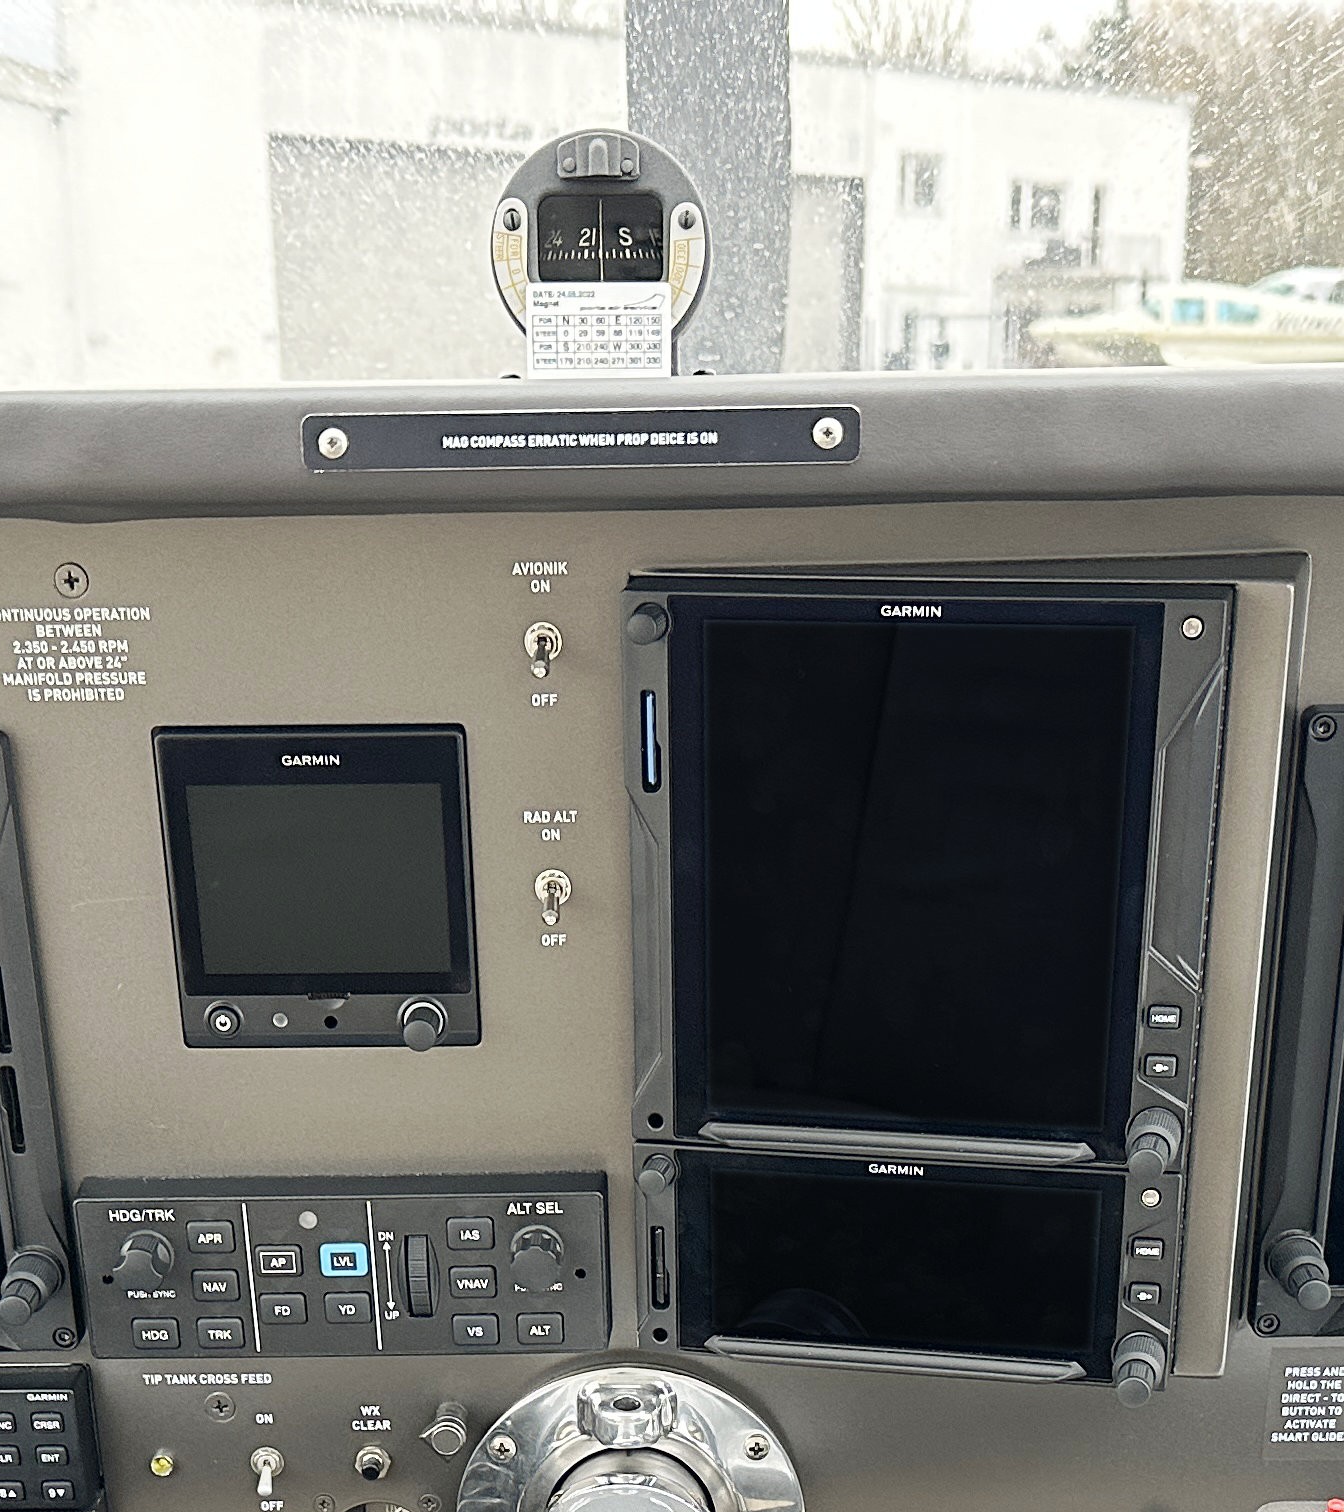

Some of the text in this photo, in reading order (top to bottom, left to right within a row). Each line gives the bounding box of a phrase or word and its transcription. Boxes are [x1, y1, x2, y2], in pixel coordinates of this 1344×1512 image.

[579, 229, 596, 246] 21
[619, 228, 633, 245] S
[616, 316, 622, 324] E
[471, 436, 526, 448] COMPASS
[528, 434, 577, 447] ERRATIC
[579, 433, 614, 446] WHEN
[617, 433, 648, 445] PROP
[650, 433, 684, 444] DEICE
[687, 433, 698, 443] IS
[700, 432, 717, 443] ON
[512, 562, 568, 576] AVIONIK
[531, 580, 550, 593] ON
[75, 608, 150, 621] OPERATION
[880, 605, 942, 618] GARMIN
[36, 624, 102, 638] BETWEEN
[14, 641, 46, 654] 2.350
[60, 641, 97, 653] 2.450
[100, 640, 128, 653] RPM
[17, 657, 35, 669] AT
[38, 657, 54, 669] OR
[58, 657, 102, 669] ABOVE
[2, 672, 146, 686] MANIFOLD PRESSURE
[28, 688, 124, 701] IS PROHIBITED
[532, 694, 558, 707] OFF
[282, 755, 340, 766] GARMIN
[524, 810, 577, 823] RAD ALT
[542, 829, 560, 841] ON
[541, 934, 567, 946] OFF
[868, 1163, 924, 1176] GARMIN
[507, 1201, 563, 1215] ALT SEL
[108, 1209, 175, 1223] HDG/TRK
[197, 1233, 223, 1245] APR
[270, 1257, 286, 1268] AP
[334, 1255, 354, 1267] LVL
[203, 1282, 227, 1293] NAV
[457, 1278, 488, 1290] VNAV
[275, 1305, 291, 1316] FD
[338, 1305, 356, 1316] YD
[142, 1329, 169, 1341] HDG
[208, 1329, 232, 1341] TRK
[530, 1325, 551, 1336] ALT
[1285, 1367, 1319, 1377] PRESS
[143, 1373, 272, 1385] TIP TANK CROSS FEED
[1288, 1380, 1342, 1390] HOLD THE
[27, 1393, 68, 1401] GARMIN
[1281, 1393, 1319, 1403] DIRECT
[1330, 1393, 1344, 1403] TO
[360, 1406, 381, 1417] WX
[1281, 1407, 1342, 1417] BUTTON TO
[256, 1414, 273, 1424] ON
[1284, 1420, 1336, 1430] ACTIVATE
[34, 1420, 60, 1431] CRSR
[352, 1420, 391, 1431] CLEAR
[1271, 1432, 1308, 1442] SMART
[41, 1453, 60, 1463] ENT
[261, 1501, 284, 1512] OFF
